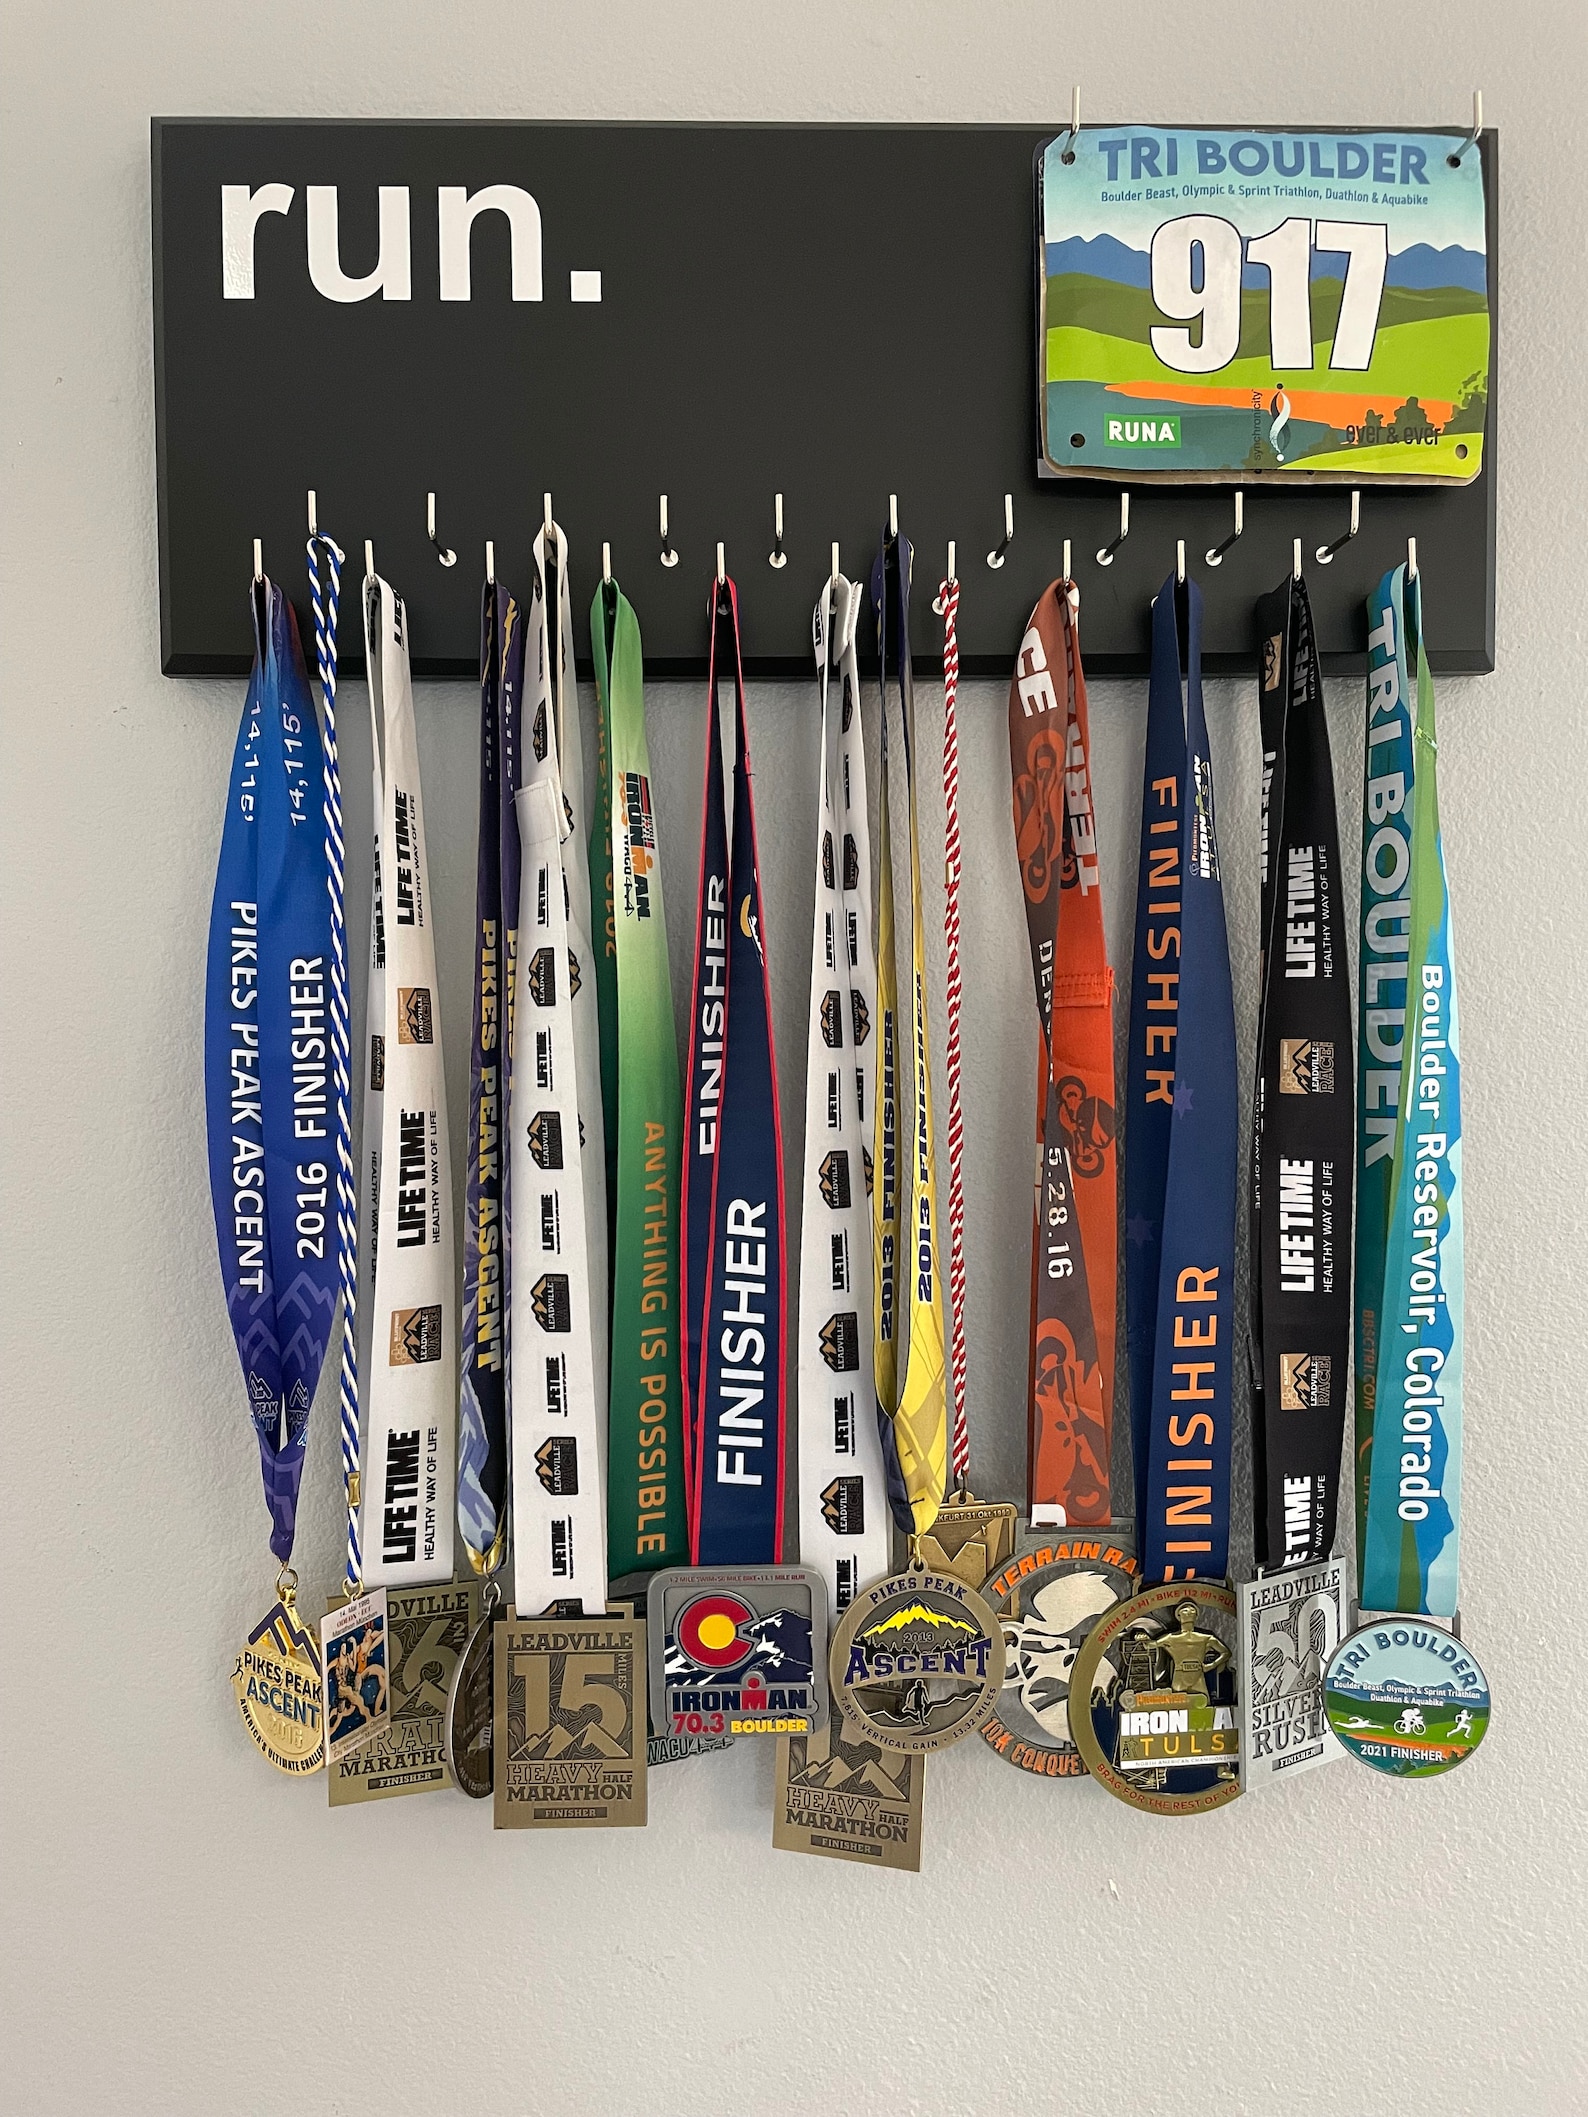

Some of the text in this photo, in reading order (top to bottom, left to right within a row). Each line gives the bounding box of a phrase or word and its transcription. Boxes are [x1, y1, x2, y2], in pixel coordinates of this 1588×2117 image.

[1098, 137, 1430, 185] TRI BOULDER
[1101, 183, 1428, 207] Boulder Beast, Olympic & Sprint Triathlon, Duathlon & Aquabike
[221, 182, 602, 303] run.
[1149, 214, 1388, 373] 917
[1108, 420, 1177, 442] RUNA
[1251, 391, 1262, 461] synchronicity
[1346, 425, 1441, 445] ever & ever
[1368, 606, 1403, 748] TRI
[282, 702, 308, 826] 14,115'
[411, 823, 417, 840] OF
[415, 875, 424, 927] HEALTHY
[1319, 844, 1333, 978] HEALTHY WAY OF LIFE
[1145, 776, 1182, 1106] FINISHER
[699, 873, 726, 1156] FINISHER
[230, 901, 265, 1294] PIKES PEAK ASCENT
[289, 956, 328, 1260] 2016 FINISHER
[431, 1140, 438, 1155] OF
[477, 918, 501, 1373] PIKES PEAK ASCENT
[431, 1160, 439, 1185] WAY
[881, 1009, 895, 1341] 2013 FINISHER
[432, 1190, 440, 1243] HEALTHY
[1048, 1147, 1074, 1279] 5.28.16
[1280, 1159, 1314, 1292] LIFE TIME
[1322, 1161, 1333, 1293] HEALTHY WAY OF LIFE
[918, 1196, 932, 1302] 2013
[1398, 963, 1447, 1521] Boulder Reservoir, Colorado
[547, 1282, 555, 1330] LEADVILLE
[420, 1315, 429, 1360] LEADVILLE
[637, 1122, 667, 1556] ANYTHING IS POSSIBLE
[717, 1198, 766, 1486] FINISHER
[837, 1321, 846, 1371] LEADVILLE
[425, 1427, 437, 1560] HEALTHY WAY OF LIFE
[553, 1445, 561, 1493] LEADVILLE
[383, 1430, 420, 1564] LIFE TIME
[840, 1484, 848, 1533] LEADVILLE
[978, 1511, 992, 1519] Okt
[1284, 1476, 1311, 1551] TIME
[1315, 1475, 1326, 1547] WAY OF LIFE
[869, 1577, 968, 1605] PIKES PEAK
[991, 1541, 1101, 1597] TERRAIN
[1250, 1567, 1340, 1610] LEADVILLE
[507, 1632, 633, 1651] LEADVILLE
[903, 1632, 934, 1643] 2013
[1098, 1589, 1212, 1644] SWIM 2.4 MI BIKE 112 MI
[1254, 1594, 1338, 1688] 50
[245, 1652, 282, 1683] PIKES
[286, 1671, 321, 1702] PEAK
[618, 1654, 626, 1689] MILES
[844, 1638, 992, 1687] ASCENT
[1336, 1629, 1479, 1690] TRI BOULDER
[247, 1677, 320, 1729] ASCENT
[514, 1656, 628, 1752] 15
[672, 1684, 808, 1712] IRONMAN
[1334, 1680, 1360, 1690] Boulder
[1363, 1683, 1385, 1693] Beast,
[1386, 1684, 1415, 1695] Olympic
[1423, 1687, 1446, 1698] Sprint
[1448, 1689, 1480, 1699] Triathlon
[1370, 1693, 1402, 1703] Duathlon
[1411, 1697, 1444, 1707] Aquabike
[240, 1699, 300, 1771] AMERICA'S ULTIMATE
[673, 1712, 808, 1734] 70.3 BOULDER
[861, 1688, 997, 1750] VERTICAL GAIN 13.32 MILES
[1252, 1710, 1327, 1760] RUSH
[507, 1762, 603, 1785] HEAVY
[603, 1773, 633, 1784] HALF
[1279, 1747, 1316, 1768] FINISHER
[1360, 1744, 1443, 1762] 2021 FINISHER
[379, 1771, 432, 1788] FINISHER
[507, 1784, 632, 1803] MARATHON
[1096, 1763, 1220, 1811] BRAG FOR THE REST OF
[545, 1808, 596, 1818] FINISHER
[786, 1786, 909, 1826] HEAVY HALF
[786, 1808, 908, 1843] MARATHON
[822, 1838, 872, 1854] FINISHER
